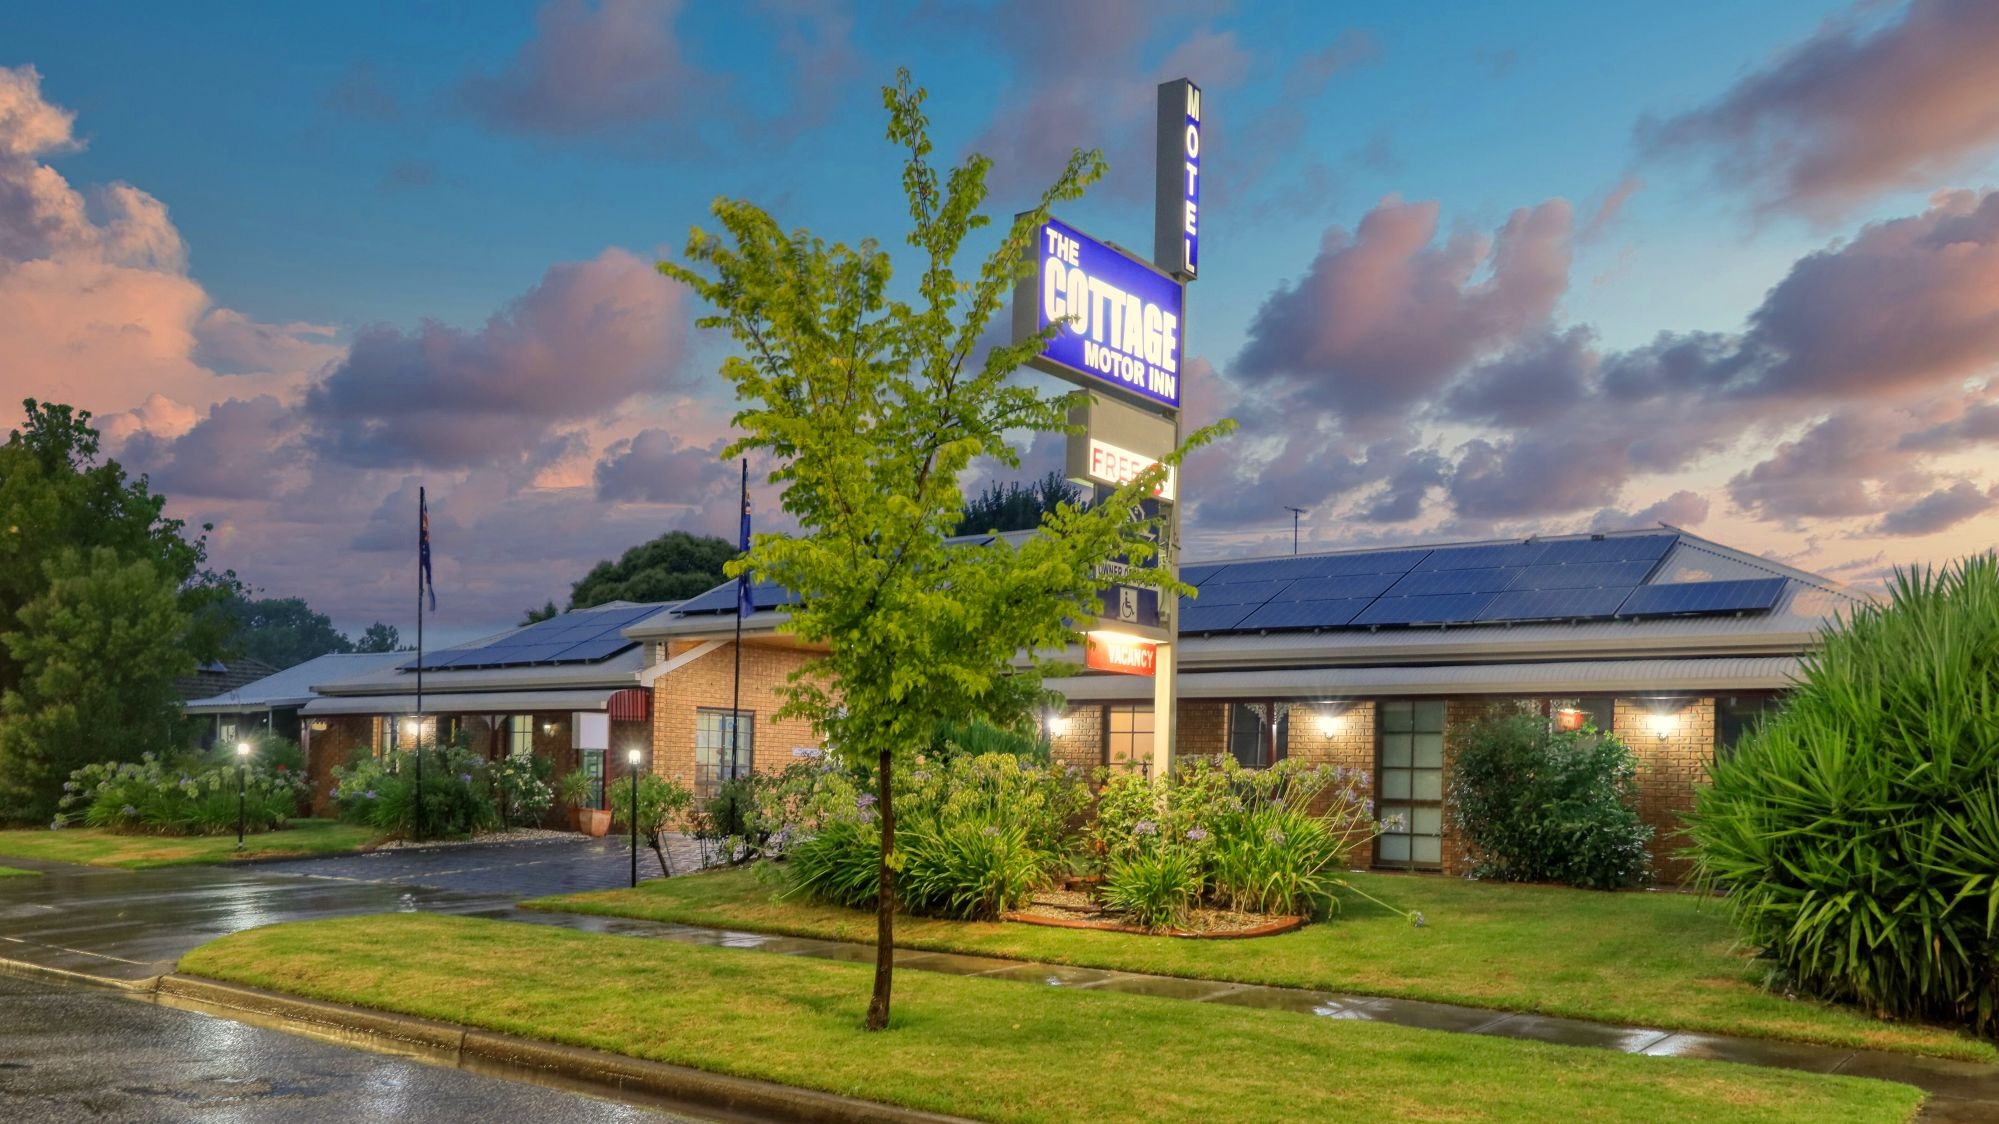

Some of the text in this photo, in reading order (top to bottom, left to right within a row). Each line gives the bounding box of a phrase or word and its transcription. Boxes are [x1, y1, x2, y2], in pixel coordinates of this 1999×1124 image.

[1185, 83, 1200, 273] MOTEL
[1046, 226, 1079, 267] THE
[1044, 256, 1177, 373] COTTAGE
[1084, 340, 1175, 400] MOTOR INN
[1108, 646, 1154, 668] VACANCY
